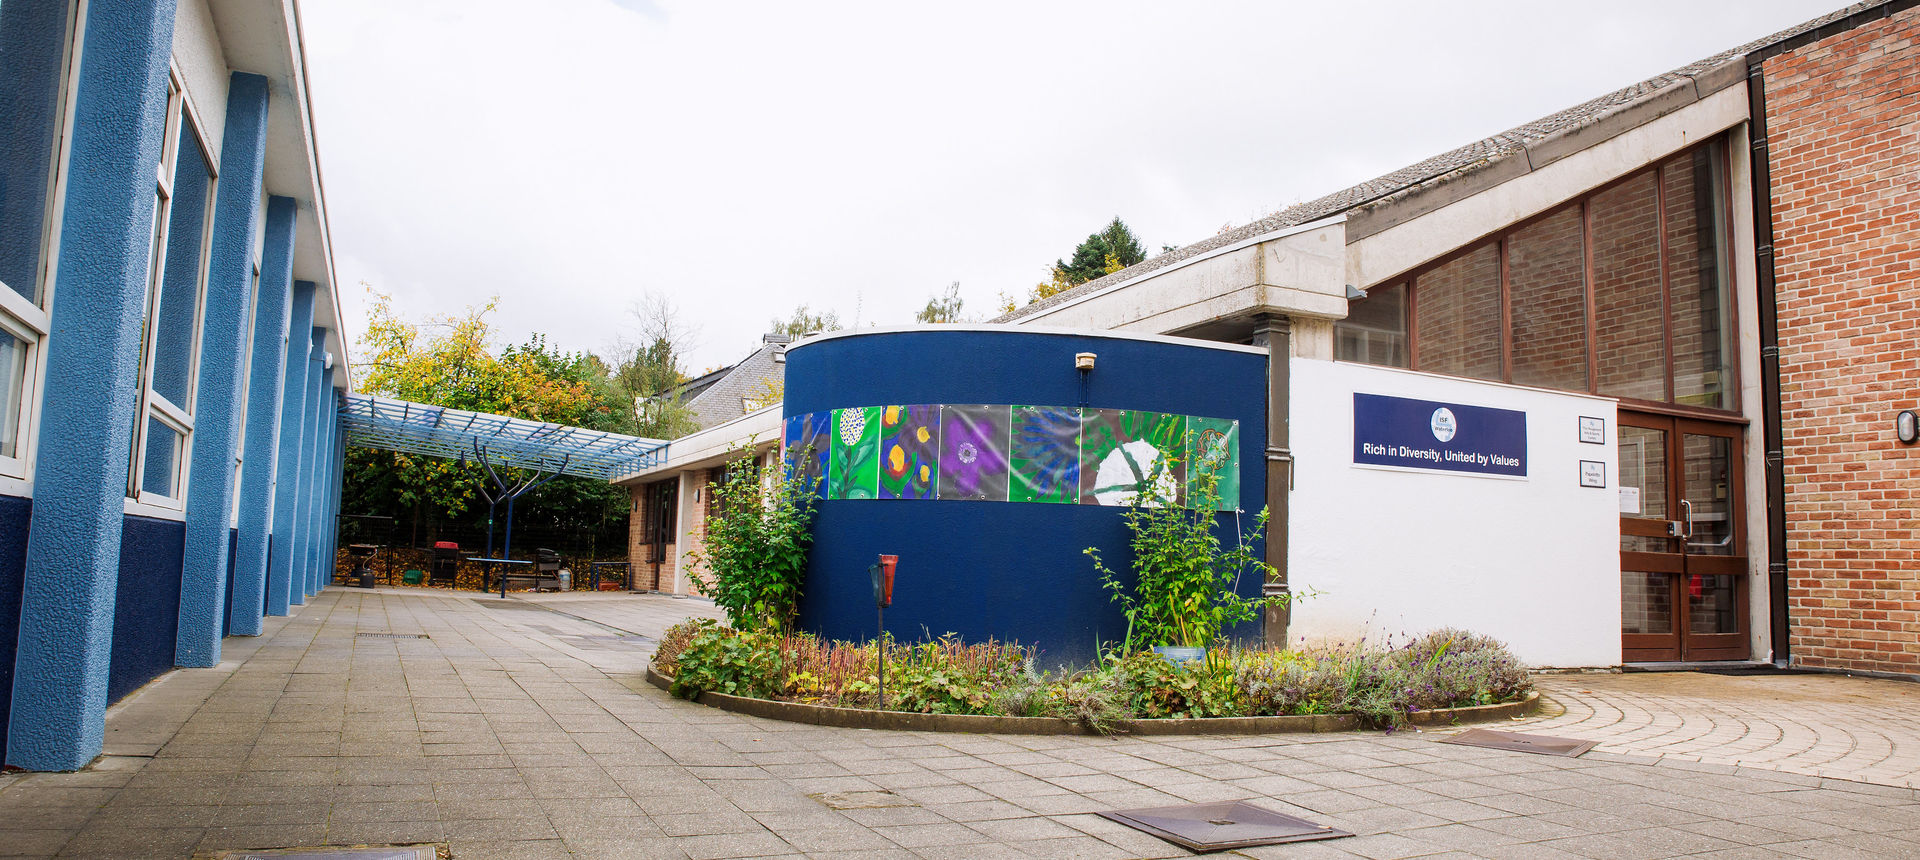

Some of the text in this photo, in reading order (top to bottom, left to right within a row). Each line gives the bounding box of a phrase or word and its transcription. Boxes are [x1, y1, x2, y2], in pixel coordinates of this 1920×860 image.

[1363, 443, 1520, 467] Rich in Diversity, United by Values
